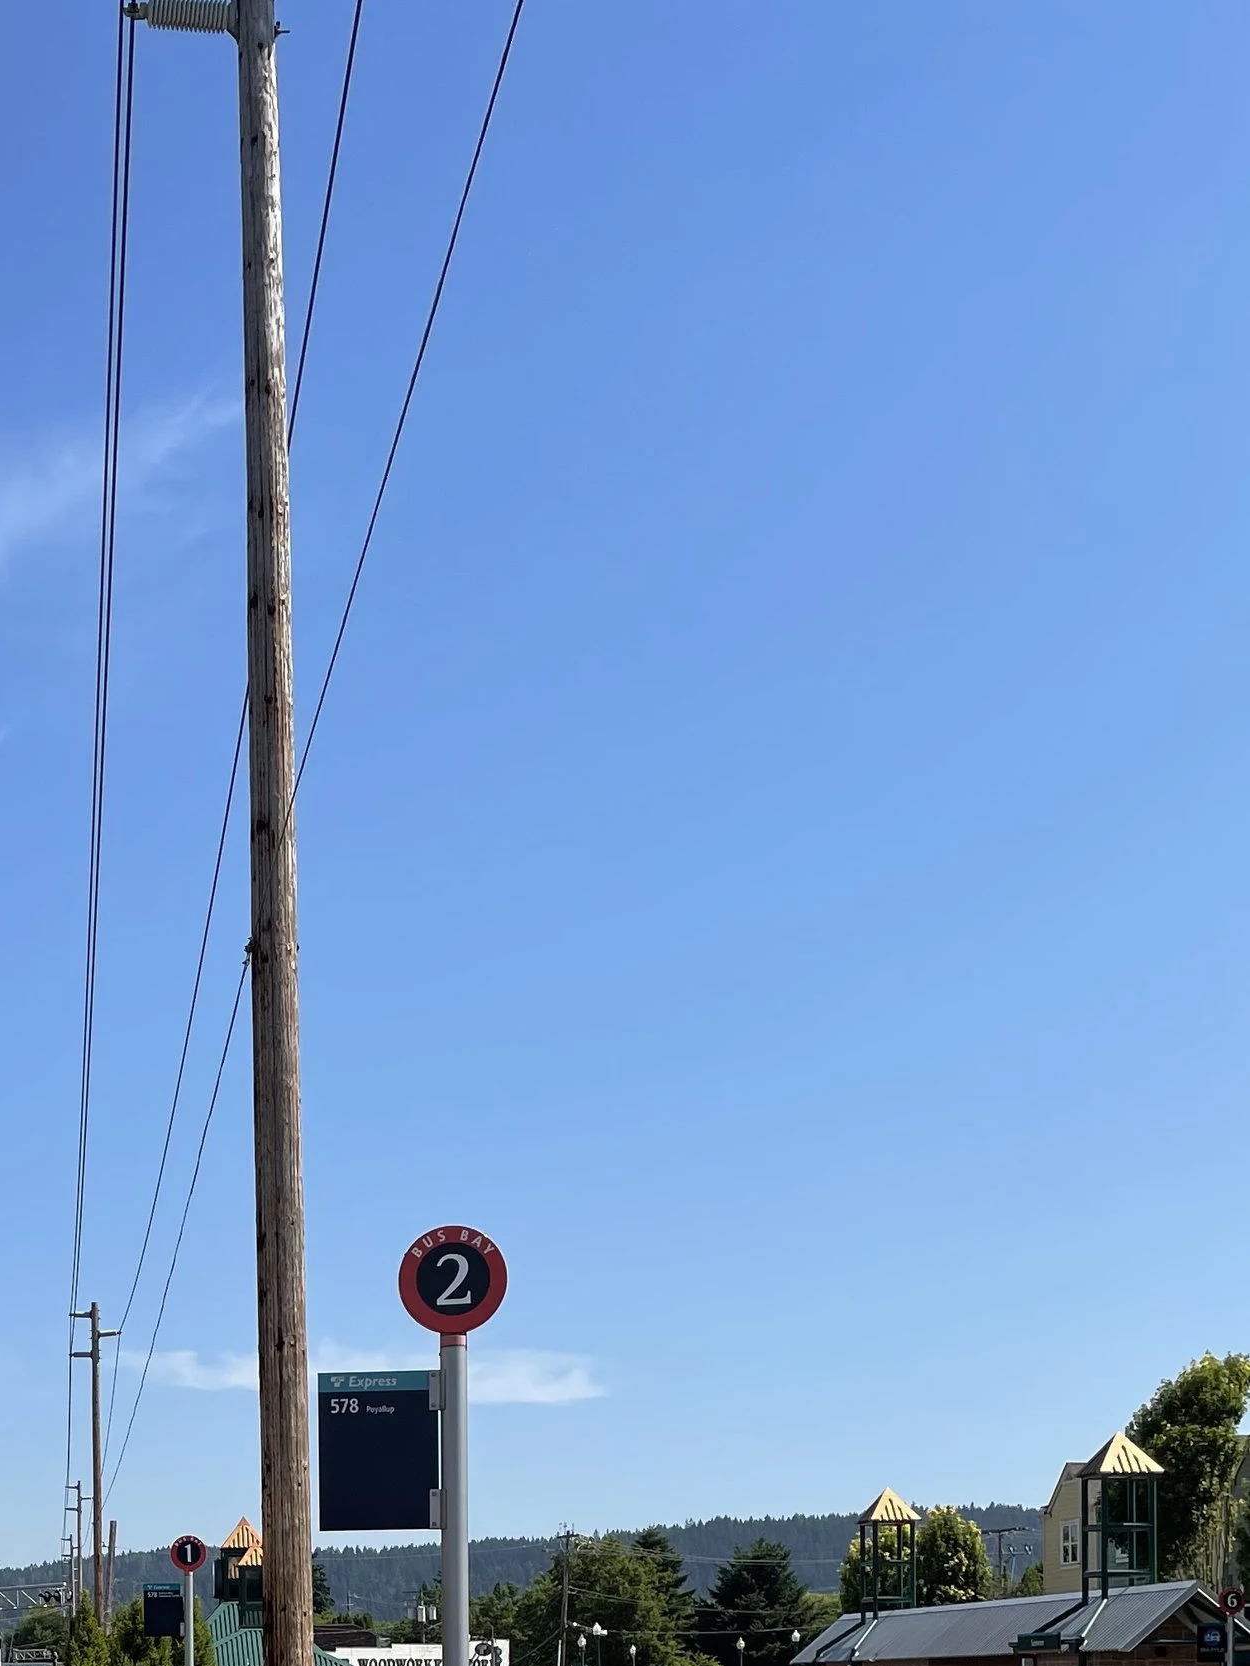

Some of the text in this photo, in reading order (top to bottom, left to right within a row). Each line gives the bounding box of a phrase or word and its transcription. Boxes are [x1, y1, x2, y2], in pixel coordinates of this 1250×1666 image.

[411, 1230, 495, 1258] BUS BAY
[436, 1253, 471, 1306] 2
[349, 1376, 398, 1390] Express
[330, 1398, 395, 1415] 578 Puyallup
[184, 1543, 192, 1563] 1
[1227, 1593, 1238, 1608] 6
